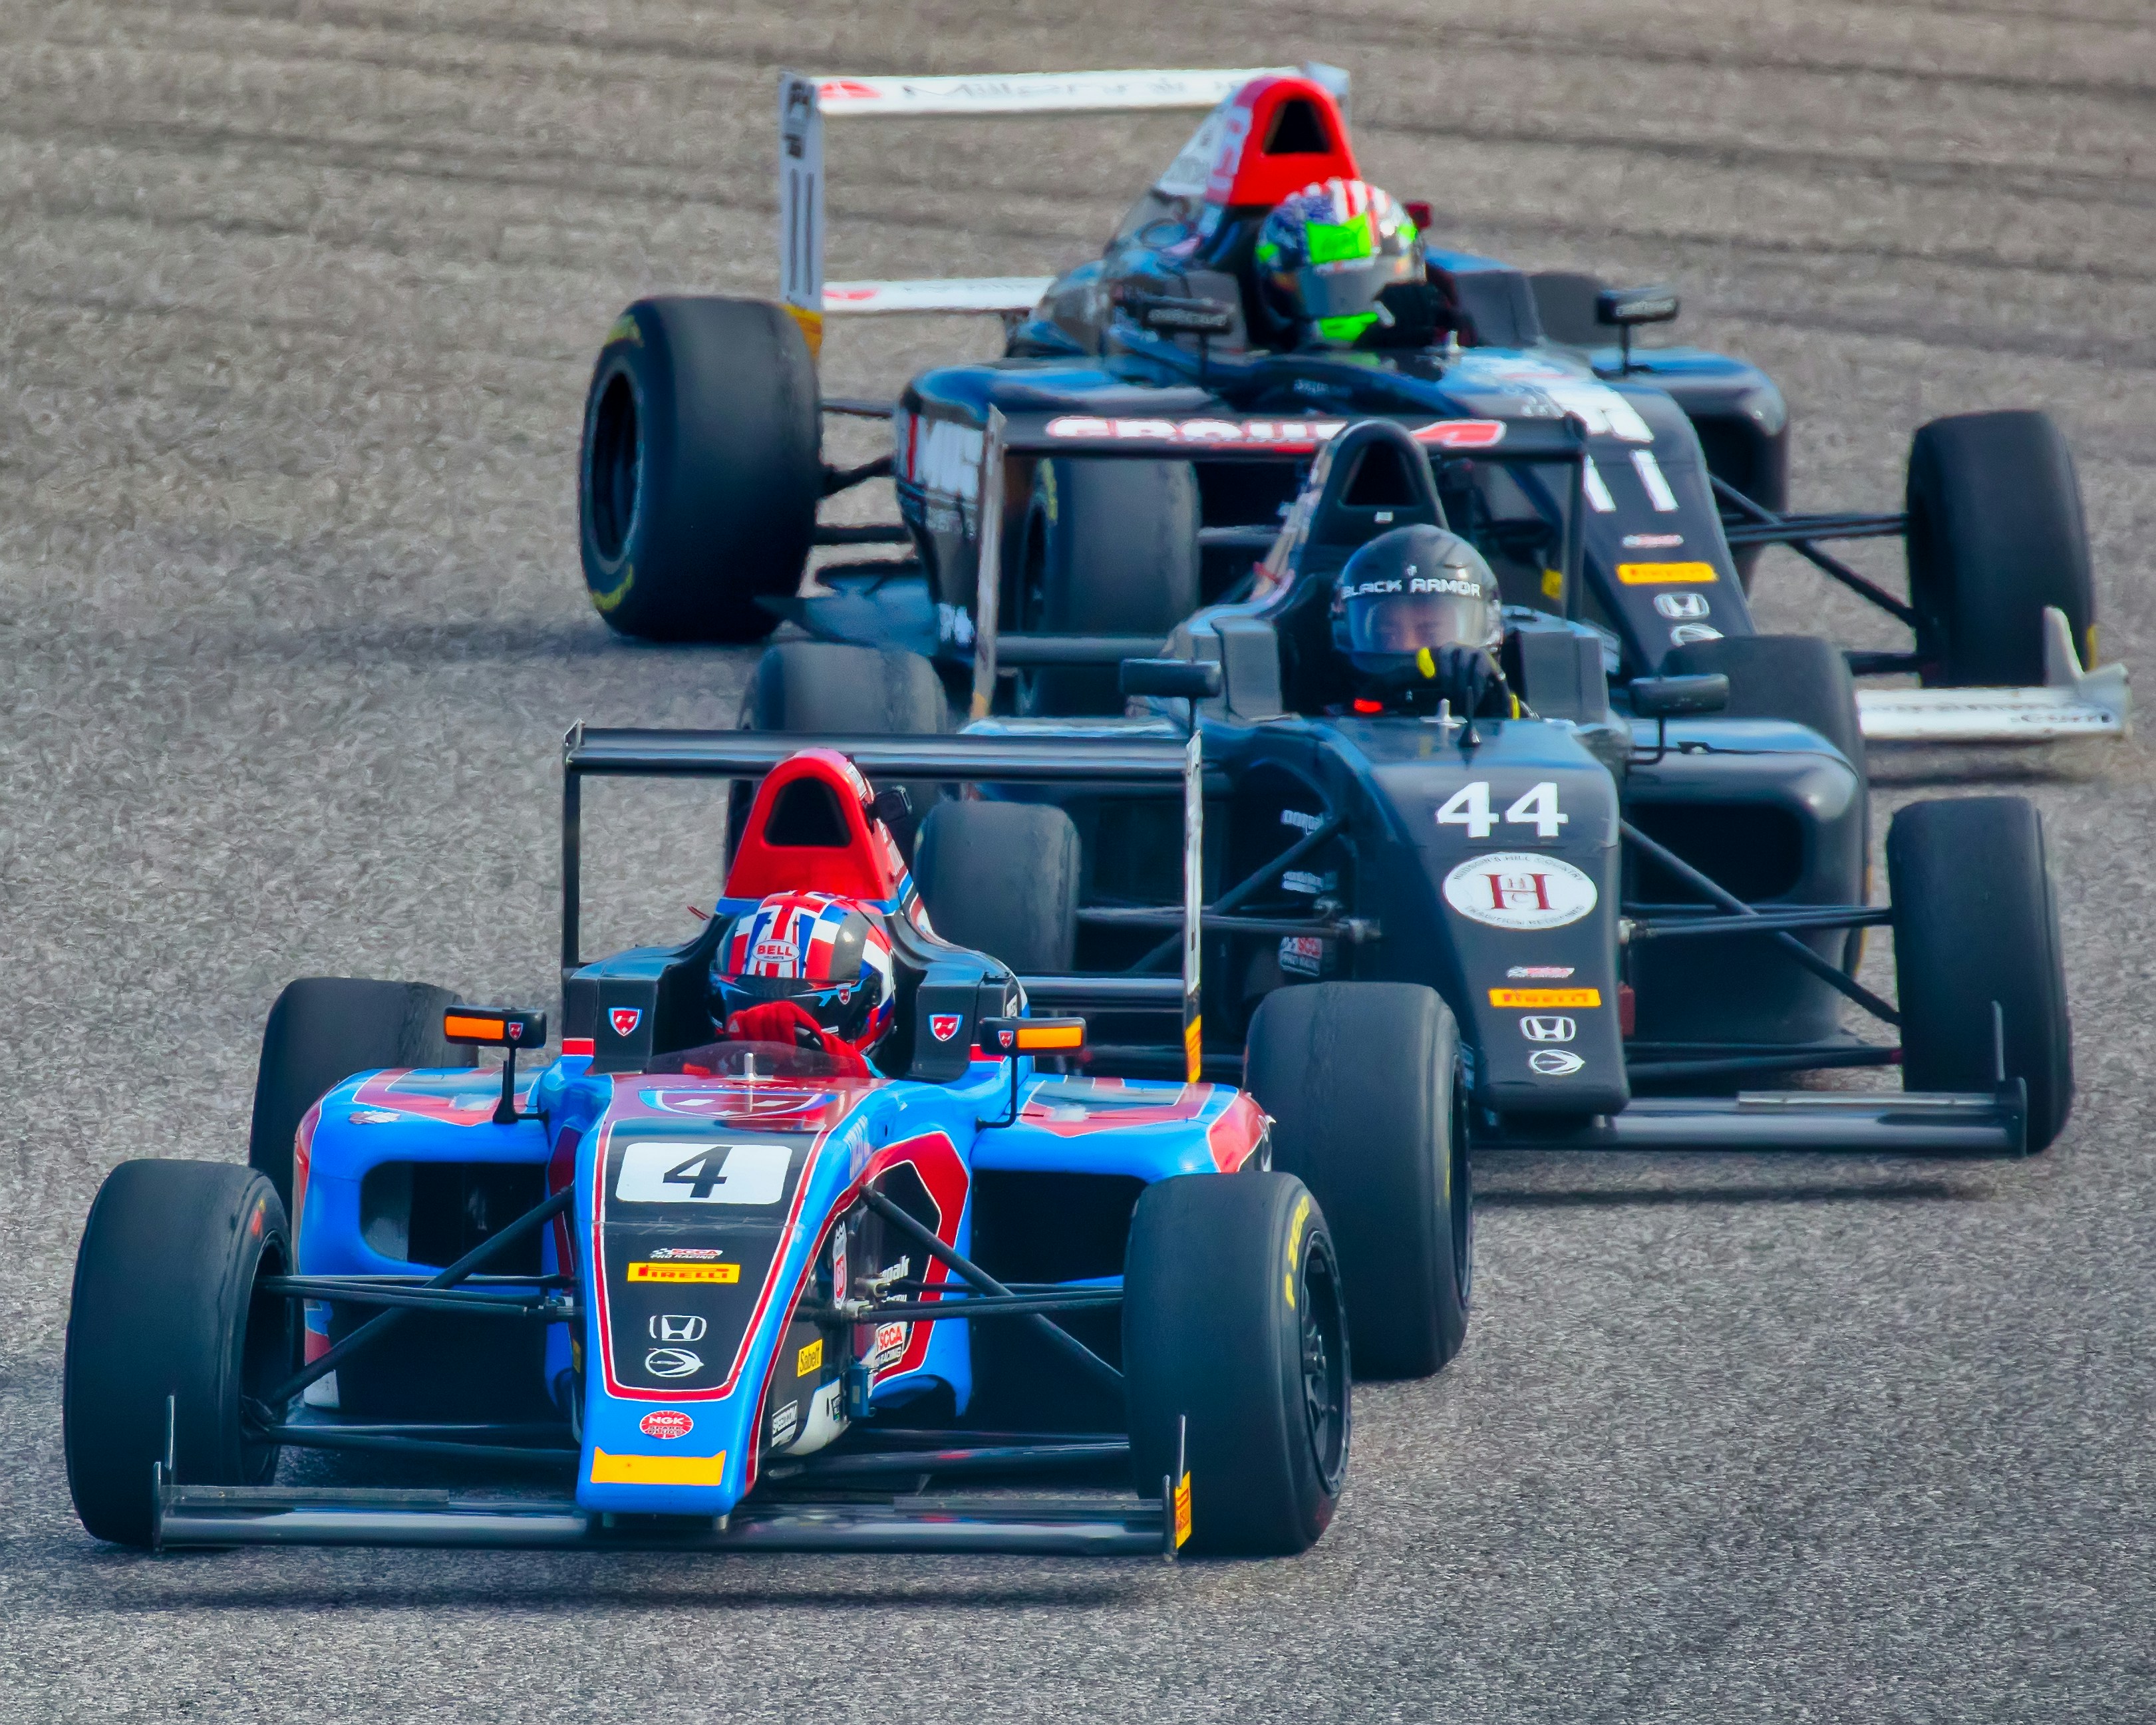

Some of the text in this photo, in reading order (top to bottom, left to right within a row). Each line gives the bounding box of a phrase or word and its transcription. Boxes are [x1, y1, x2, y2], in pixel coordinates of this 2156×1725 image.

[1340, 577, 1481, 599] BLACK ARMOR
[1435, 781, 1569, 838] 44
[756, 945, 793, 957] BELL
[662, 1146, 734, 1198] 4
[639, 1265, 730, 1278] PIRELLI
[879, 1326, 903, 1350] SCCA
[649, 1416, 685, 1425] NGK
